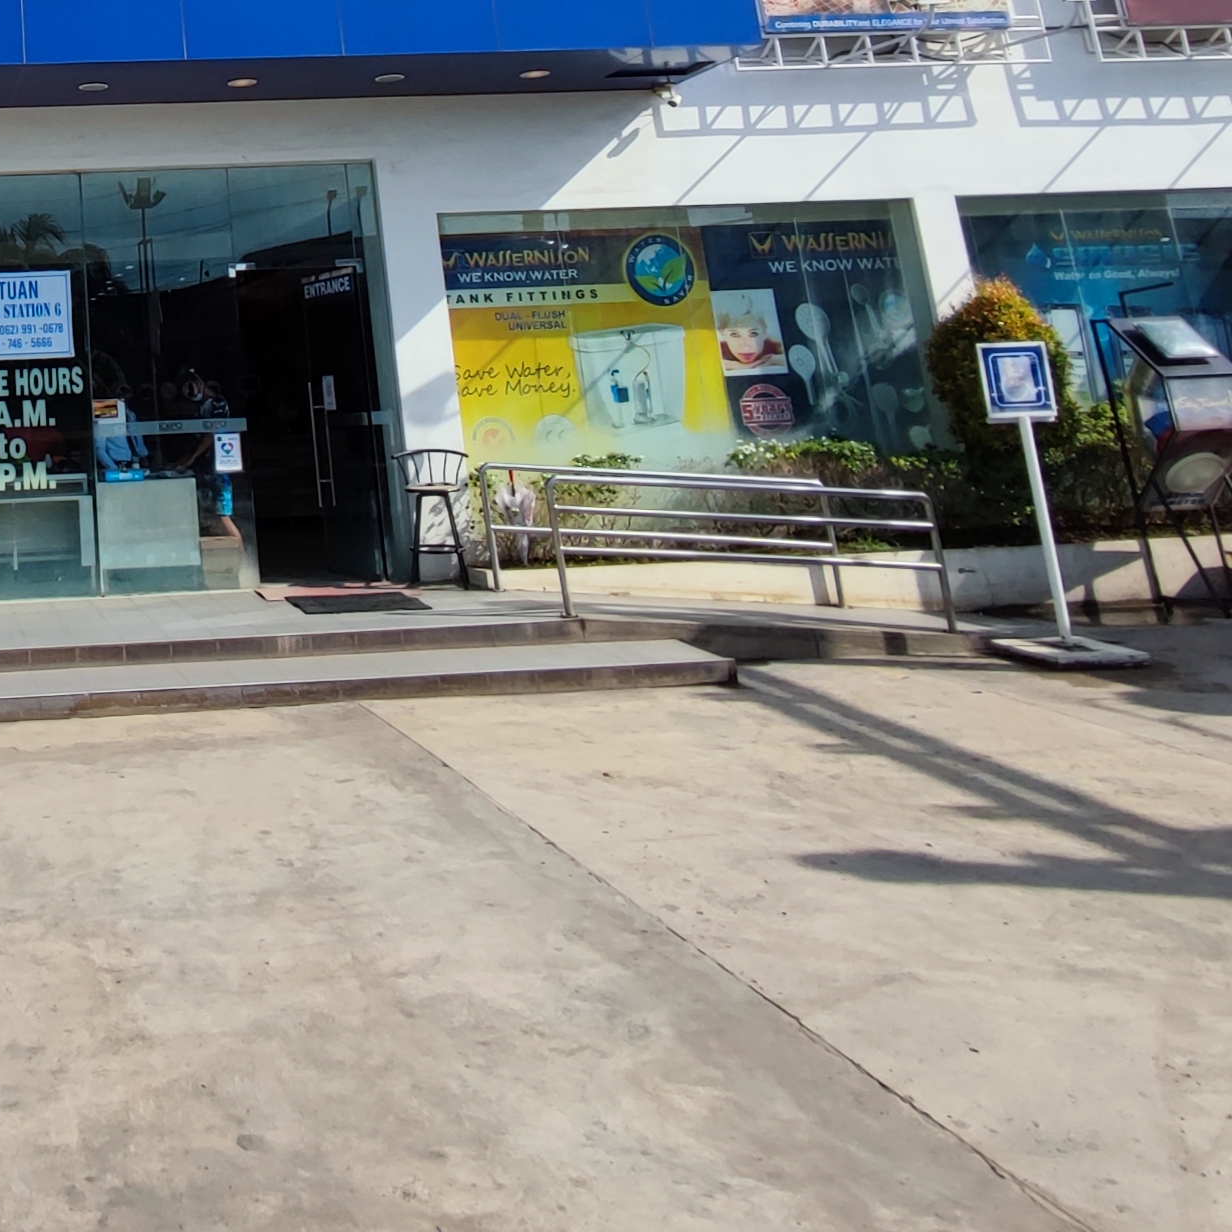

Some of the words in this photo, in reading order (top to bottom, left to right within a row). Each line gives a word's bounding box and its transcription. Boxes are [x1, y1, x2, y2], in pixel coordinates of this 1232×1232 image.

[768, 260, 797, 274] WE
[801, 258, 853, 272] KNOW
[458, 272, 482, 283] WE
[484, 271, 527, 282] KNOW
[528, 269, 579, 280] WATER
[304, 276, 351, 298] ENTRANCE
[506, 289, 599, 303] FITTINGS
[4, 302, 51, 318] STATION
[54, 302, 62, 317] 6
[495, 311, 523, 321] DUAL
[531, 310, 566, 319] FLUSH
[21, 324, 37, 334] 991
[508, 320, 567, 331] UNIVERSAL
[7, 338, 23, 349] 746
[30, 337, 53, 348] 5666
[505, 361, 571, 379] Water,
[15, 366, 84, 396] HOURS
[457, 382, 499, 397] ave
[505, 378, 576, 398] Money.
